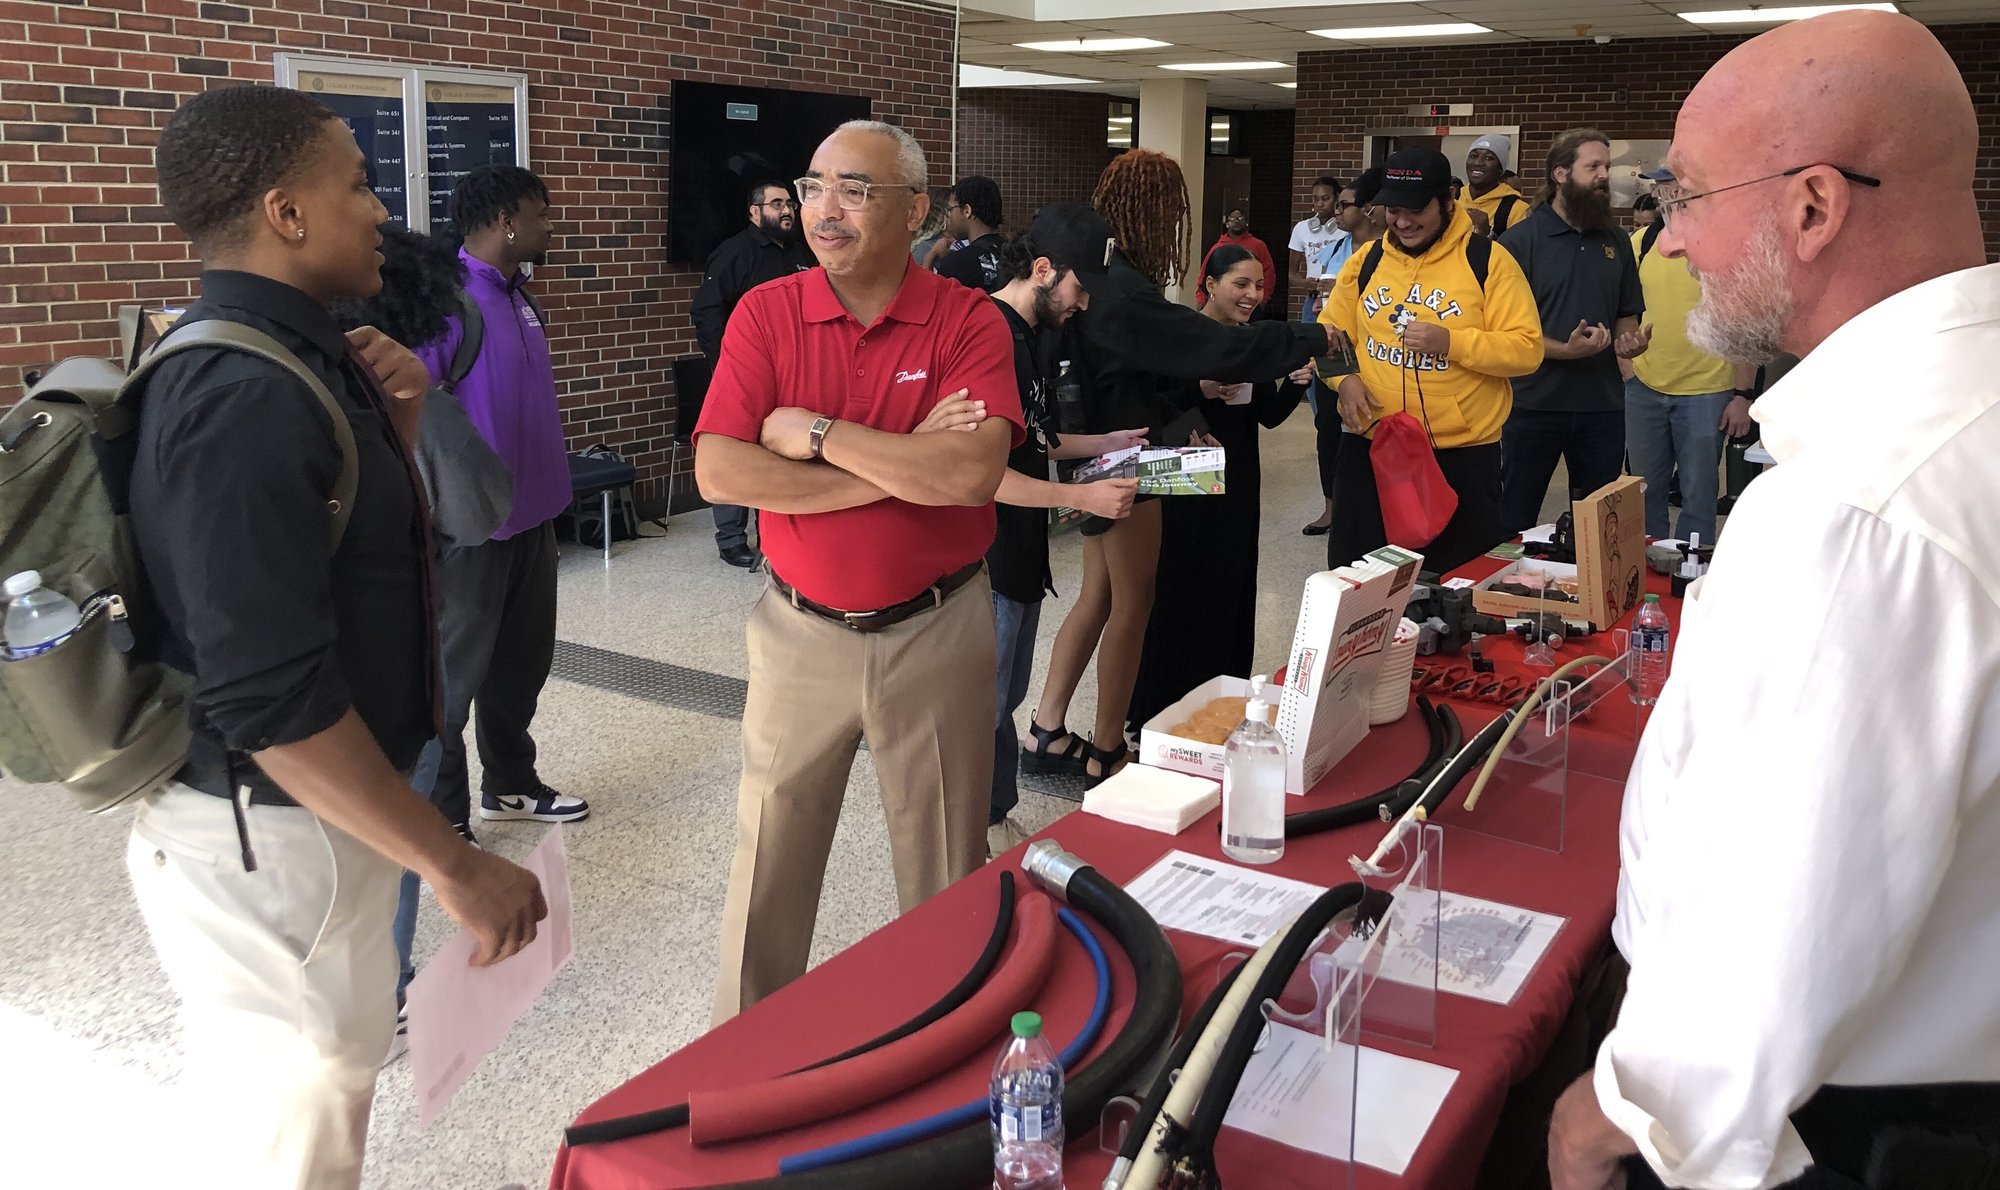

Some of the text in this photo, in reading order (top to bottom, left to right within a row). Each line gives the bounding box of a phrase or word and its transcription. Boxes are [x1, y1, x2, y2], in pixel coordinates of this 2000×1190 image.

[1386, 168, 1422, 176] HONDA
[1363, 283, 1463, 320] NC A&T
[1366, 336, 1450, 371] AGGIES
[895, 368, 928, 384] Danfoss
[1159, 476, 1196, 484] Danfoss
[1169, 752, 1203, 766] REWARDS
